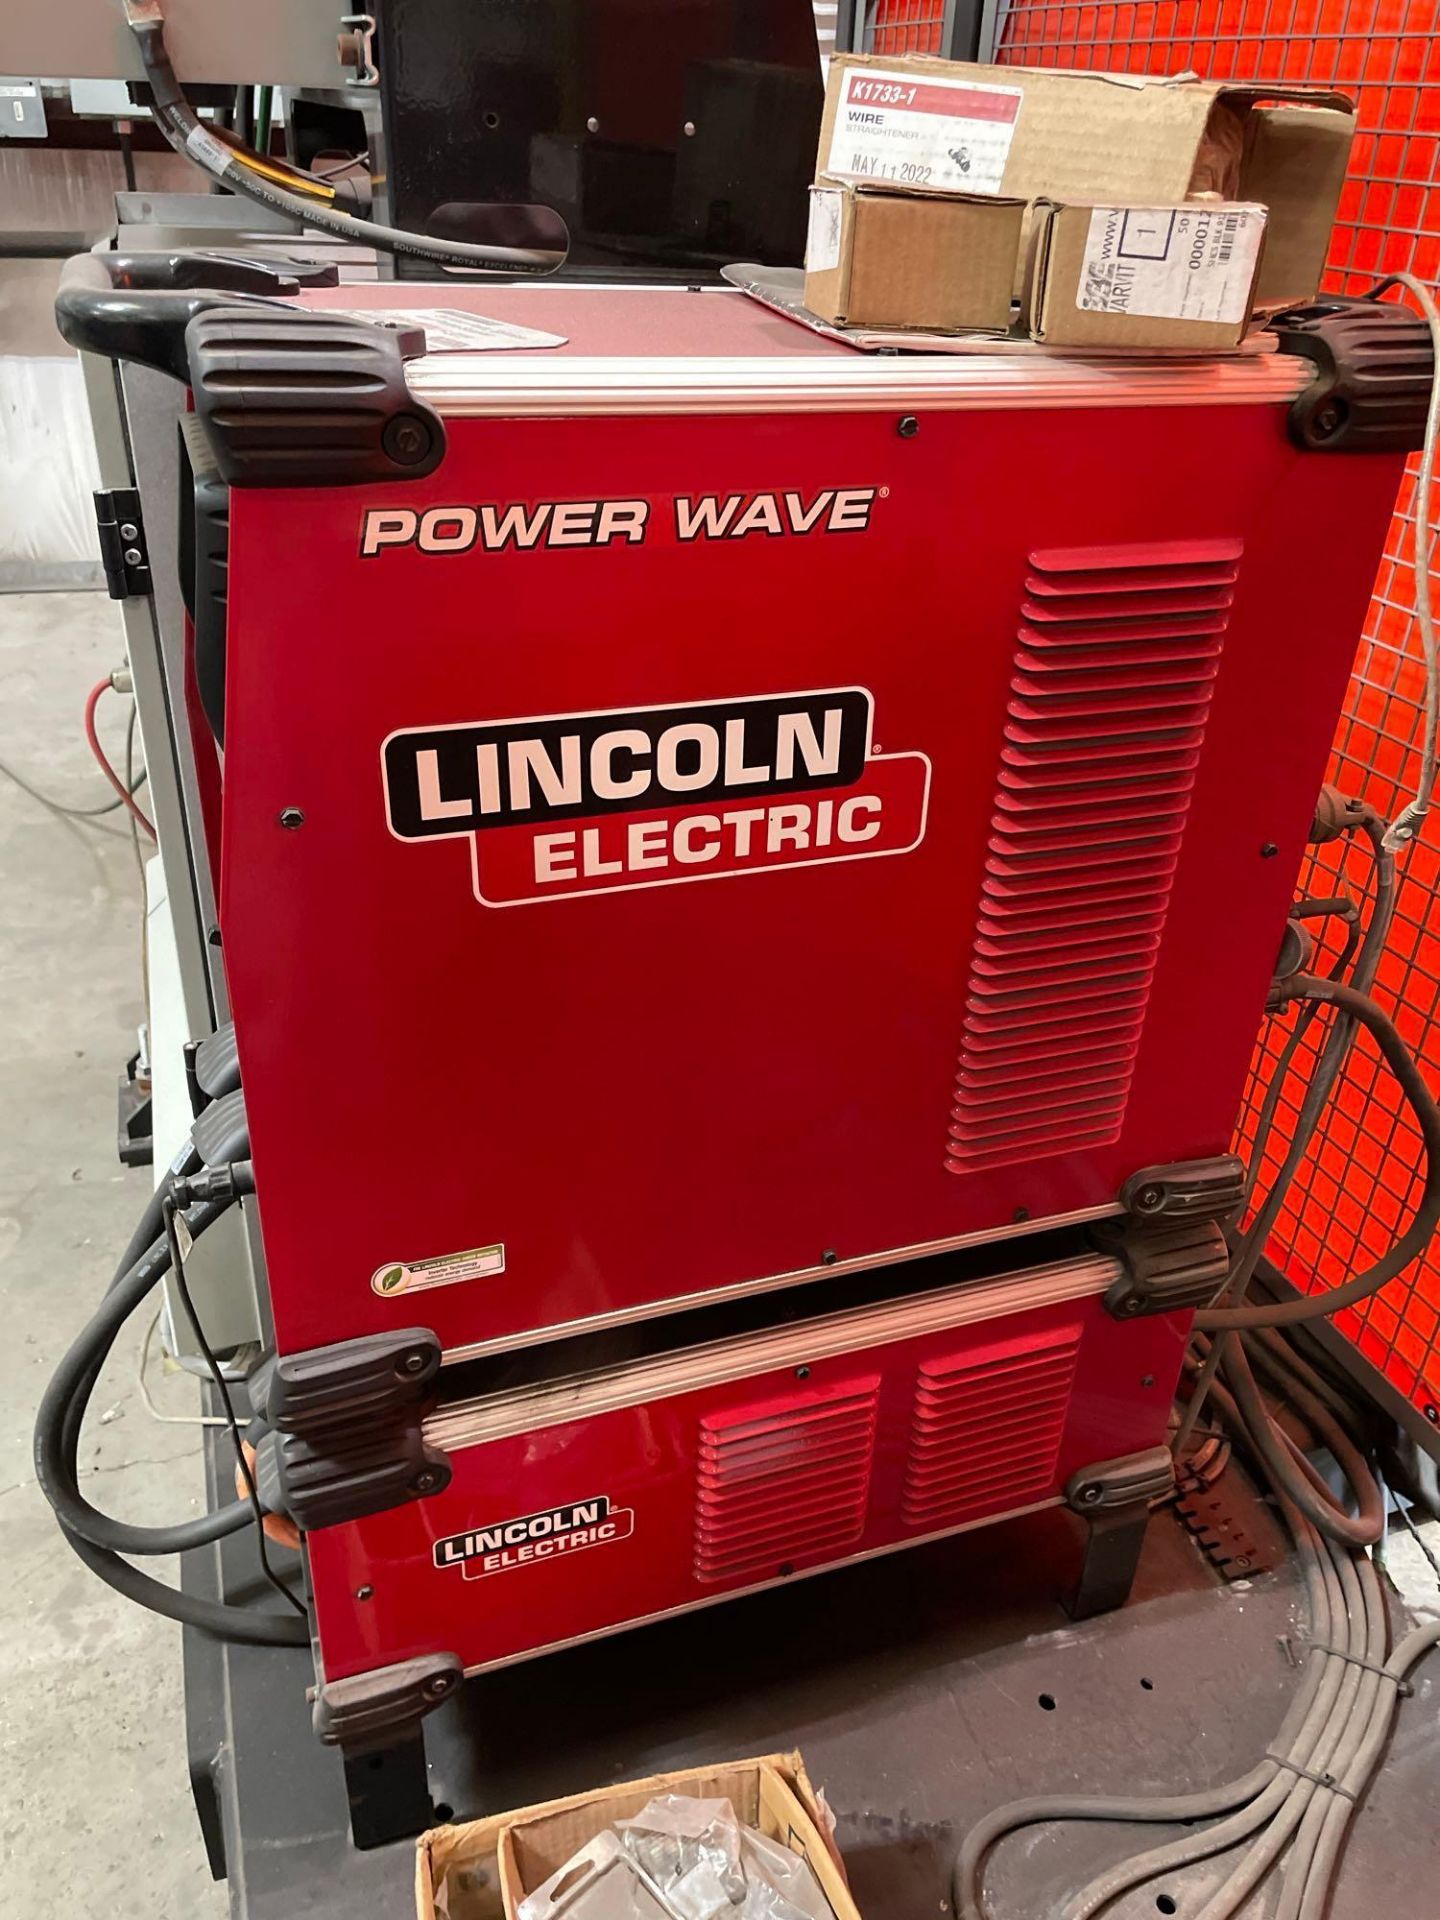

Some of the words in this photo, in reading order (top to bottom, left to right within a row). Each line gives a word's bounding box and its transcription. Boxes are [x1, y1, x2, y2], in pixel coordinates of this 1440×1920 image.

[851, 81, 917, 105] K1733-1
[845, 123, 919, 139] STRAIGHTENER
[849, 111, 884, 125] WIRE
[851, 154, 879, 176] MAY
[899, 162, 933, 184] 2022
[263, 191, 275, 202] TO
[303, 211, 327, 227] MADE
[329, 221, 340, 232] IN
[342, 226, 360, 238] USA
[1136, 228, 1156, 238] 1
[451, 255, 479, 268] ROYAL
[361, 499, 648, 558] POWER
[415, 708, 843, 821] LINCOLN
[534, 794, 883, 883] ELECTRIC
[445, 1502, 598, 1561] LINCOLN
[484, 1523, 616, 1571] ELECTRIC
